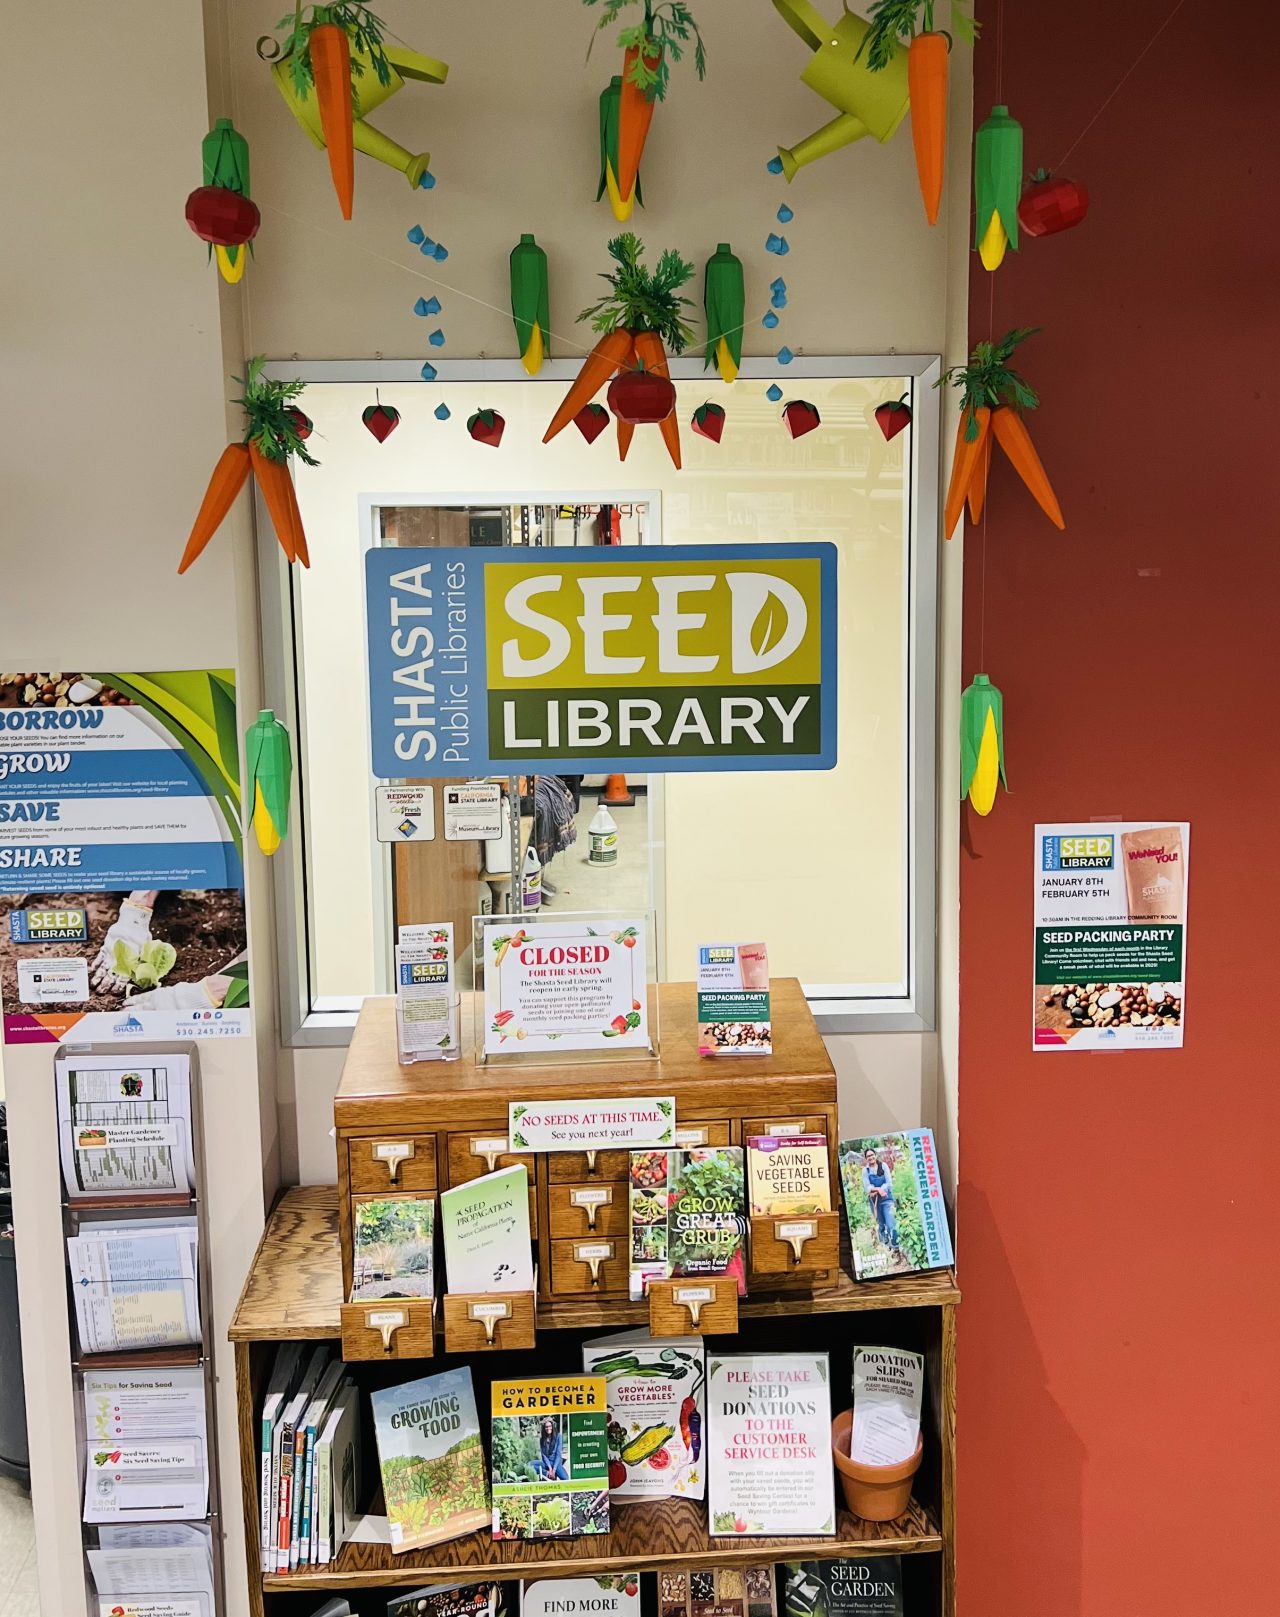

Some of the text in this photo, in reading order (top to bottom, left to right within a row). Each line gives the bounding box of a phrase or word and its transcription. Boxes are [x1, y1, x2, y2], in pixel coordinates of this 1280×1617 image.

[502, 572, 808, 678] SEED
[390, 562, 437, 762] SHASTA
[438, 562, 469, 762] Public Libraries
[503, 696, 811, 748] LIBRARY
[0, 802, 60, 822] SAVE
[1062, 839, 1111, 856] SEED
[0, 848, 82, 868] SHARE
[1062, 858, 1110, 867] LIBRARY
[1156, 853, 1178, 863] YOU!
[12, 912, 21, 940] SHASTA
[30, 912, 81, 928] SEED
[31, 929, 82, 938] LIBRARY
[1043, 930, 1175, 943] SEED PACKING PARTY
[520, 945, 610, 965] CLOSED
[414, 963, 446, 976] SEED
[567, 967, 602, 975] SEASON
[522, 1112, 662, 1127] NO SEEDS AT THIS TIME.
[551, 1128, 633, 1141] See you next year!
[769, 1154, 811, 1166] SAVING
[921, 1135, 939, 1198] REKHA'S
[757, 1167, 824, 1180] VEGETABLE
[772, 1181, 810, 1193] SEEDS
[679, 1197, 734, 1214] GROW
[912, 1136, 940, 1261] KITCHEN GARDEN
[457, 1200, 513, 1226] PROPAGATION
[464, 1201, 486, 1214] SEED
[677, 1212, 735, 1229] GREAT
[682, 1230, 731, 1245] GRUB
[863, 1354, 916, 1370] DONATION
[727, 1371, 810, 1383] PLEASE TAKE
[876, 1366, 905, 1378] SLIPS
[546, 1385, 584, 1393] BECOME
[748, 1385, 788, 1398] SEED
[503, 1394, 595, 1409] GARDENER
[723, 1401, 816, 1416] DONATIONS
[391, 1397, 460, 1430] GROWING
[419, 1414, 461, 1438] FOOD
[745, 1419, 795, 1431] TO THE
[733, 1433, 807, 1445] CUSTOMER
[725, 1447, 816, 1459] SERVICE DESK
[831, 1566, 870, 1580] SEED
[831, 1581, 895, 1596] GARDEN
[437, 1601, 488, 1617] YEAR-ROUND
[544, 1599, 618, 1612] FIND MORE
